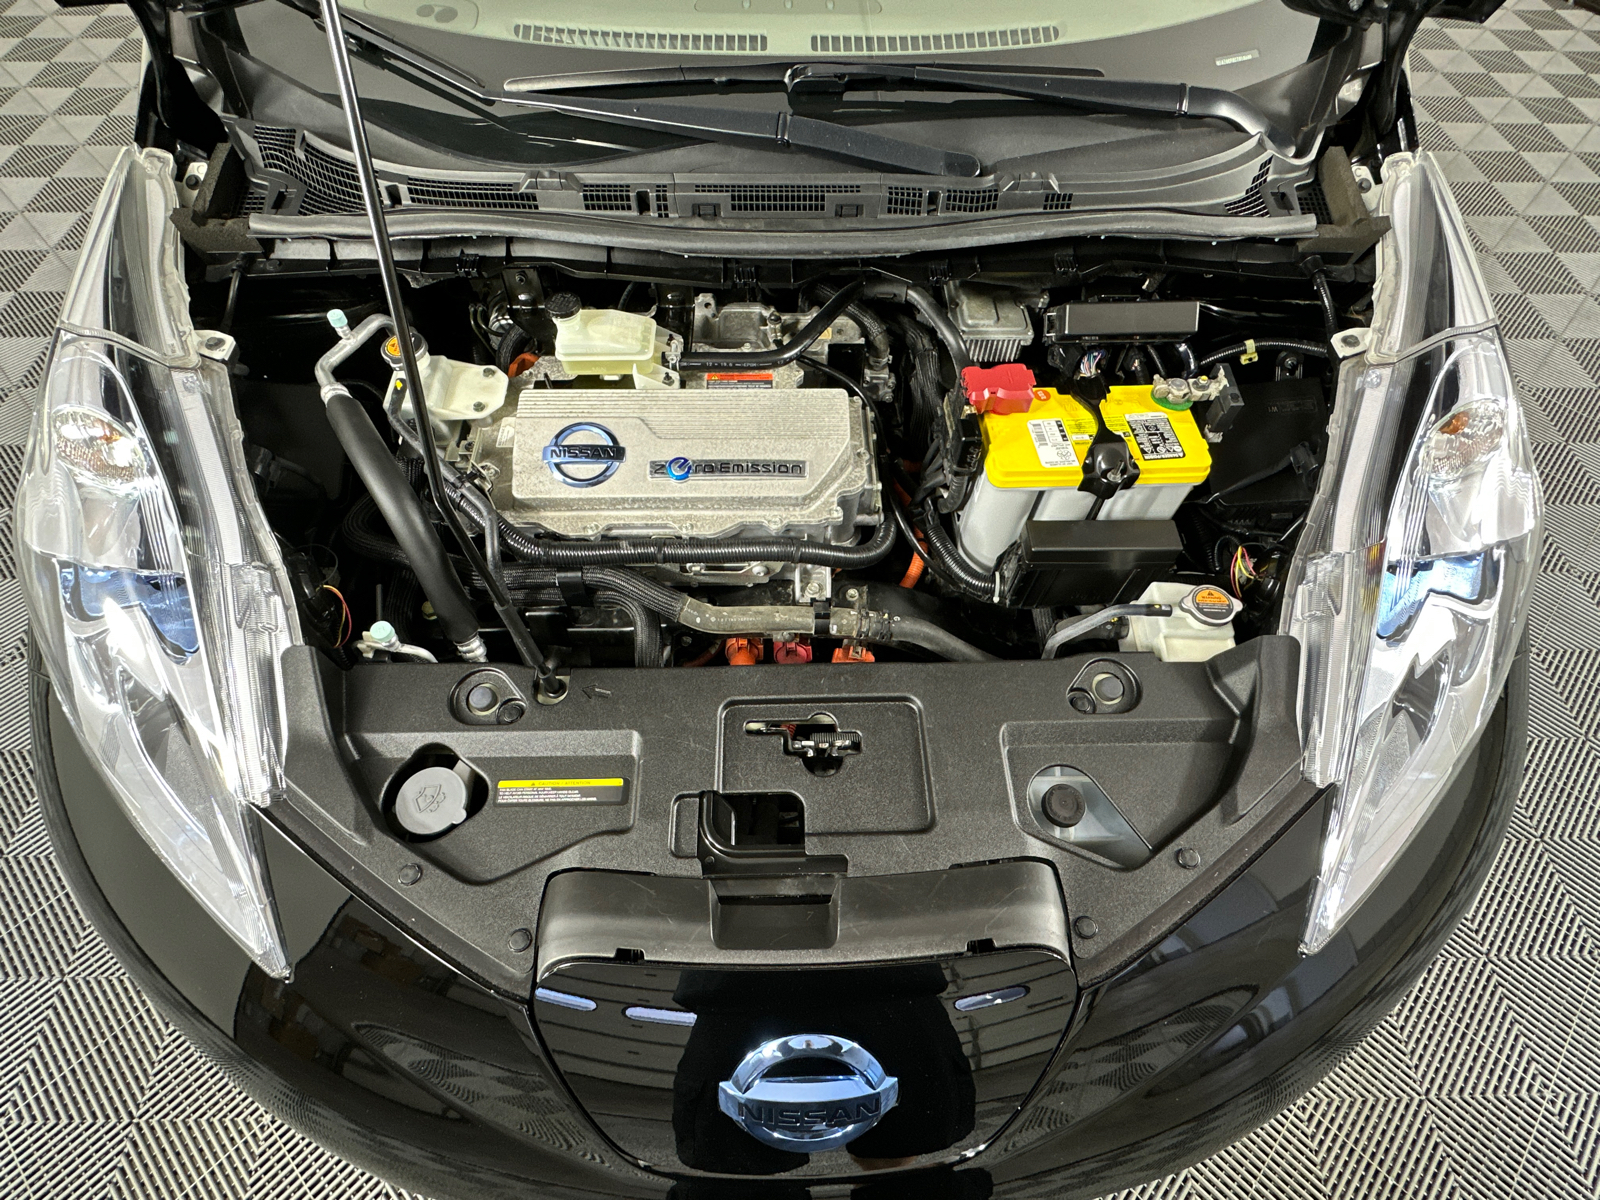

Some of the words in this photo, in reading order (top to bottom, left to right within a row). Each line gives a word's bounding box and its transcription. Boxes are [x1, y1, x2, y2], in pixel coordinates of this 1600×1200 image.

[550, 447, 617, 459] NISSAN
[719, 461, 802, 474] Emission
[739, 1096, 881, 1126] NISSAN
